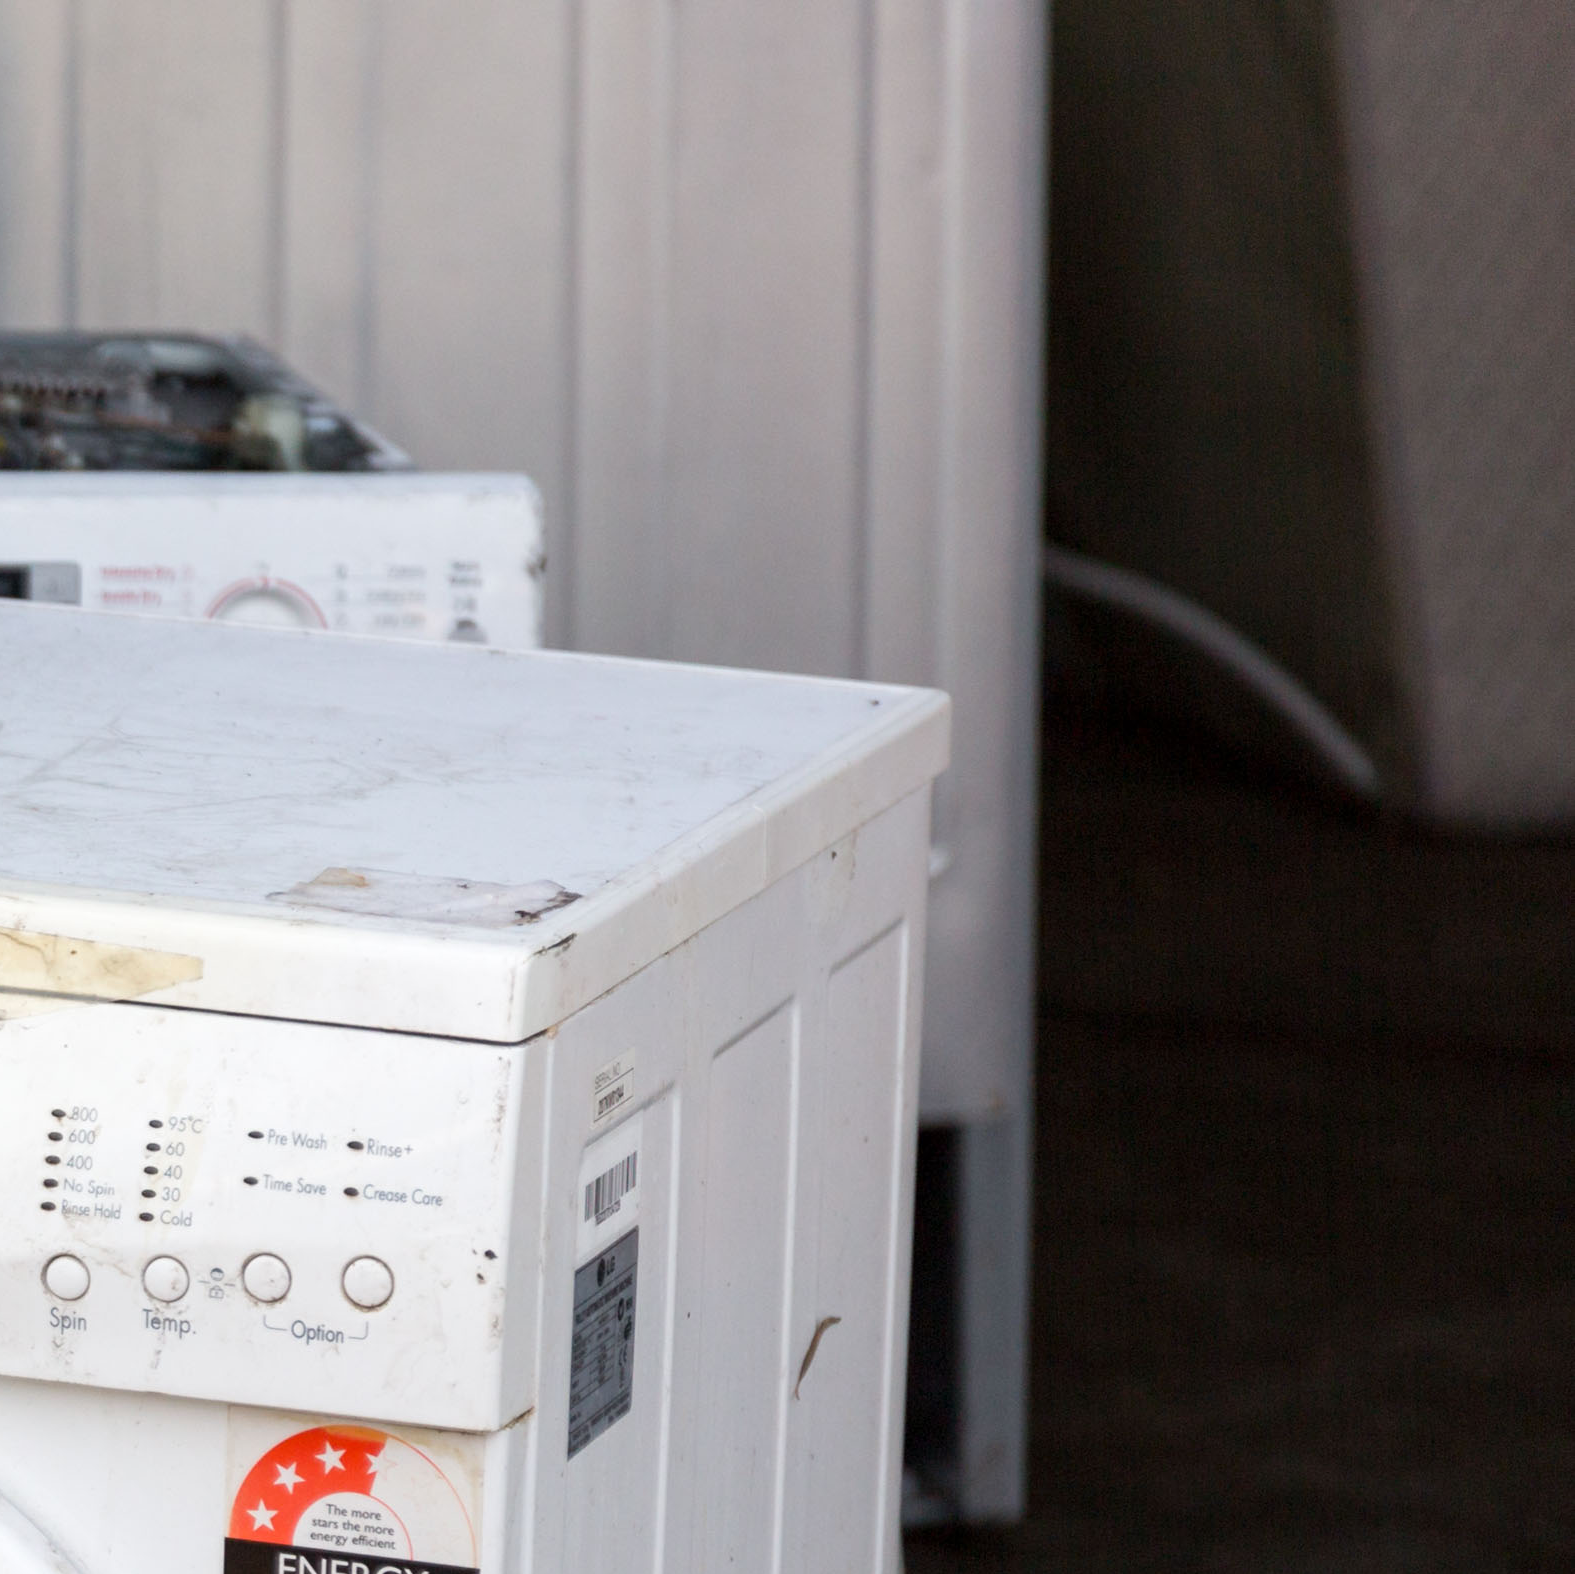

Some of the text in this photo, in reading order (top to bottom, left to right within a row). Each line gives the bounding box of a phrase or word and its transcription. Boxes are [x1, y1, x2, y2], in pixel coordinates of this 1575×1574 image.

[71, 1106, 98, 1122] 800
[168, 1116, 203, 1134] 95°C
[68, 1130, 95, 1145] 600
[268, 1128, 328, 1150] Pre Wash
[166, 1142, 185, 1157] 60
[366, 1138, 413, 1158] Rinse+
[67, 1155, 93, 1170] 400
[163, 1165, 182, 1180] 40
[63, 1179, 115, 1198] No Spin
[263, 1174, 327, 1196] Time Save
[162, 1187, 181, 1202] 30
[363, 1183, 443, 1206] Crease Care
[61, 1200, 121, 1220] Rinse Hold
[160, 1210, 193, 1227] Cold
[49, 1307, 87, 1335] Spin
[142, 1307, 197, 1336] Temp.
[290, 1319, 345, 1345] Option
[325, 1503, 382, 1521] The more
[312, 1517, 394, 1536] stars the more
[310, 1532, 396, 1550] energy efficient
